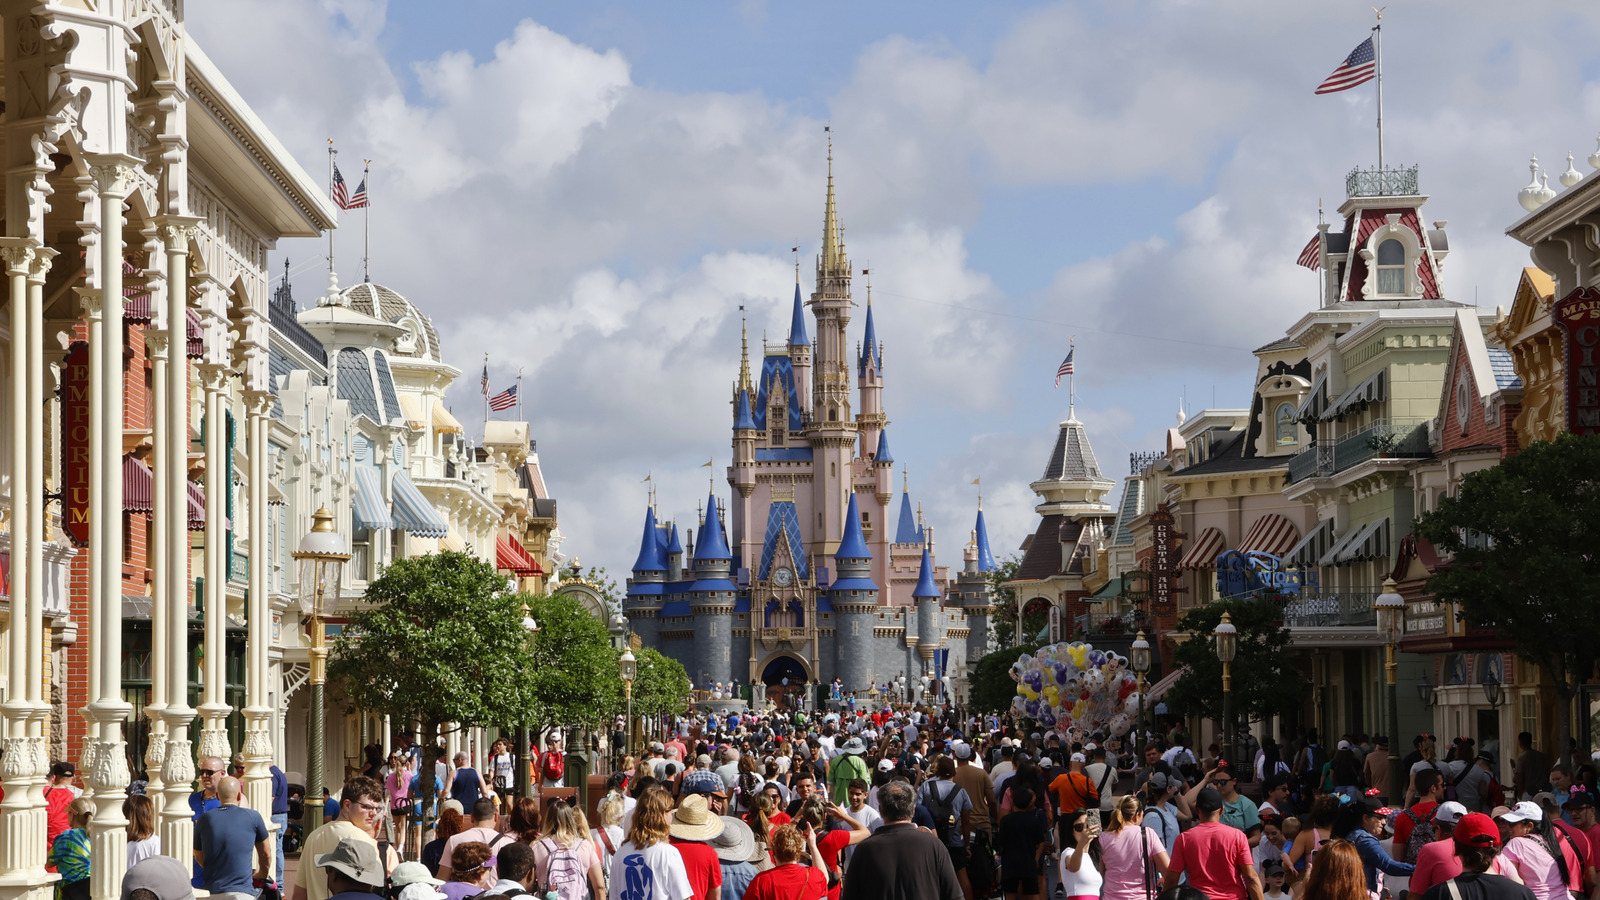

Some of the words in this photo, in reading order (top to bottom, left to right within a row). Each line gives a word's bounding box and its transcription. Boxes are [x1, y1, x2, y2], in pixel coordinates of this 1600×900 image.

[69, 364, 89, 524] EMPORIUM
[1158, 525, 1167, 570] CRYSTAL
[1158, 576, 1168, 602] ARTS
